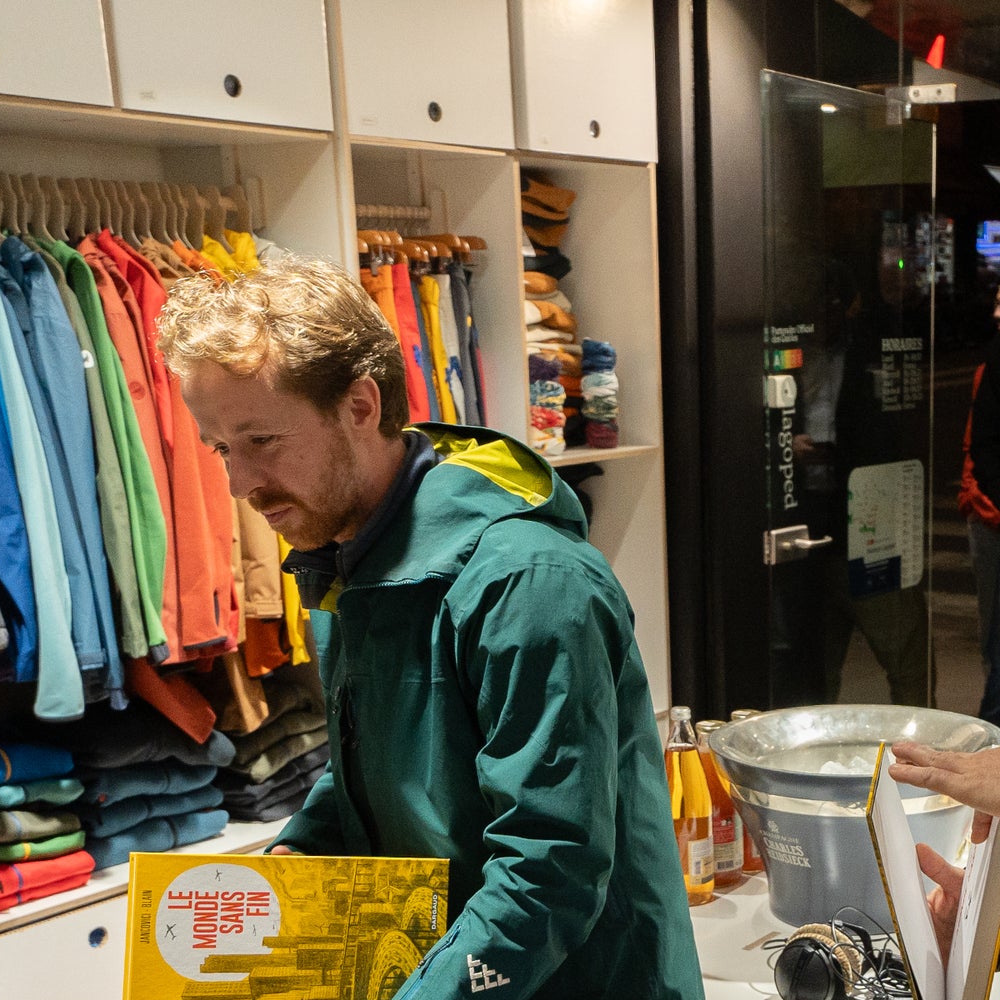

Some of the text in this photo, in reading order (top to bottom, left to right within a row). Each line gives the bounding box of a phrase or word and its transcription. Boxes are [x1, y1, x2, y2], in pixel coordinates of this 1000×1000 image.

[778, 408, 799, 510] lagoped
[139, 889, 153, 945] JANCOVICI BLAIN
[167, 890, 193, 910] LE
[192, 890, 220, 949] MONDE
[219, 891, 246, 935] SANS
[246, 891, 271, 917] FIN
[431, 894, 439, 930] DARGAUD
